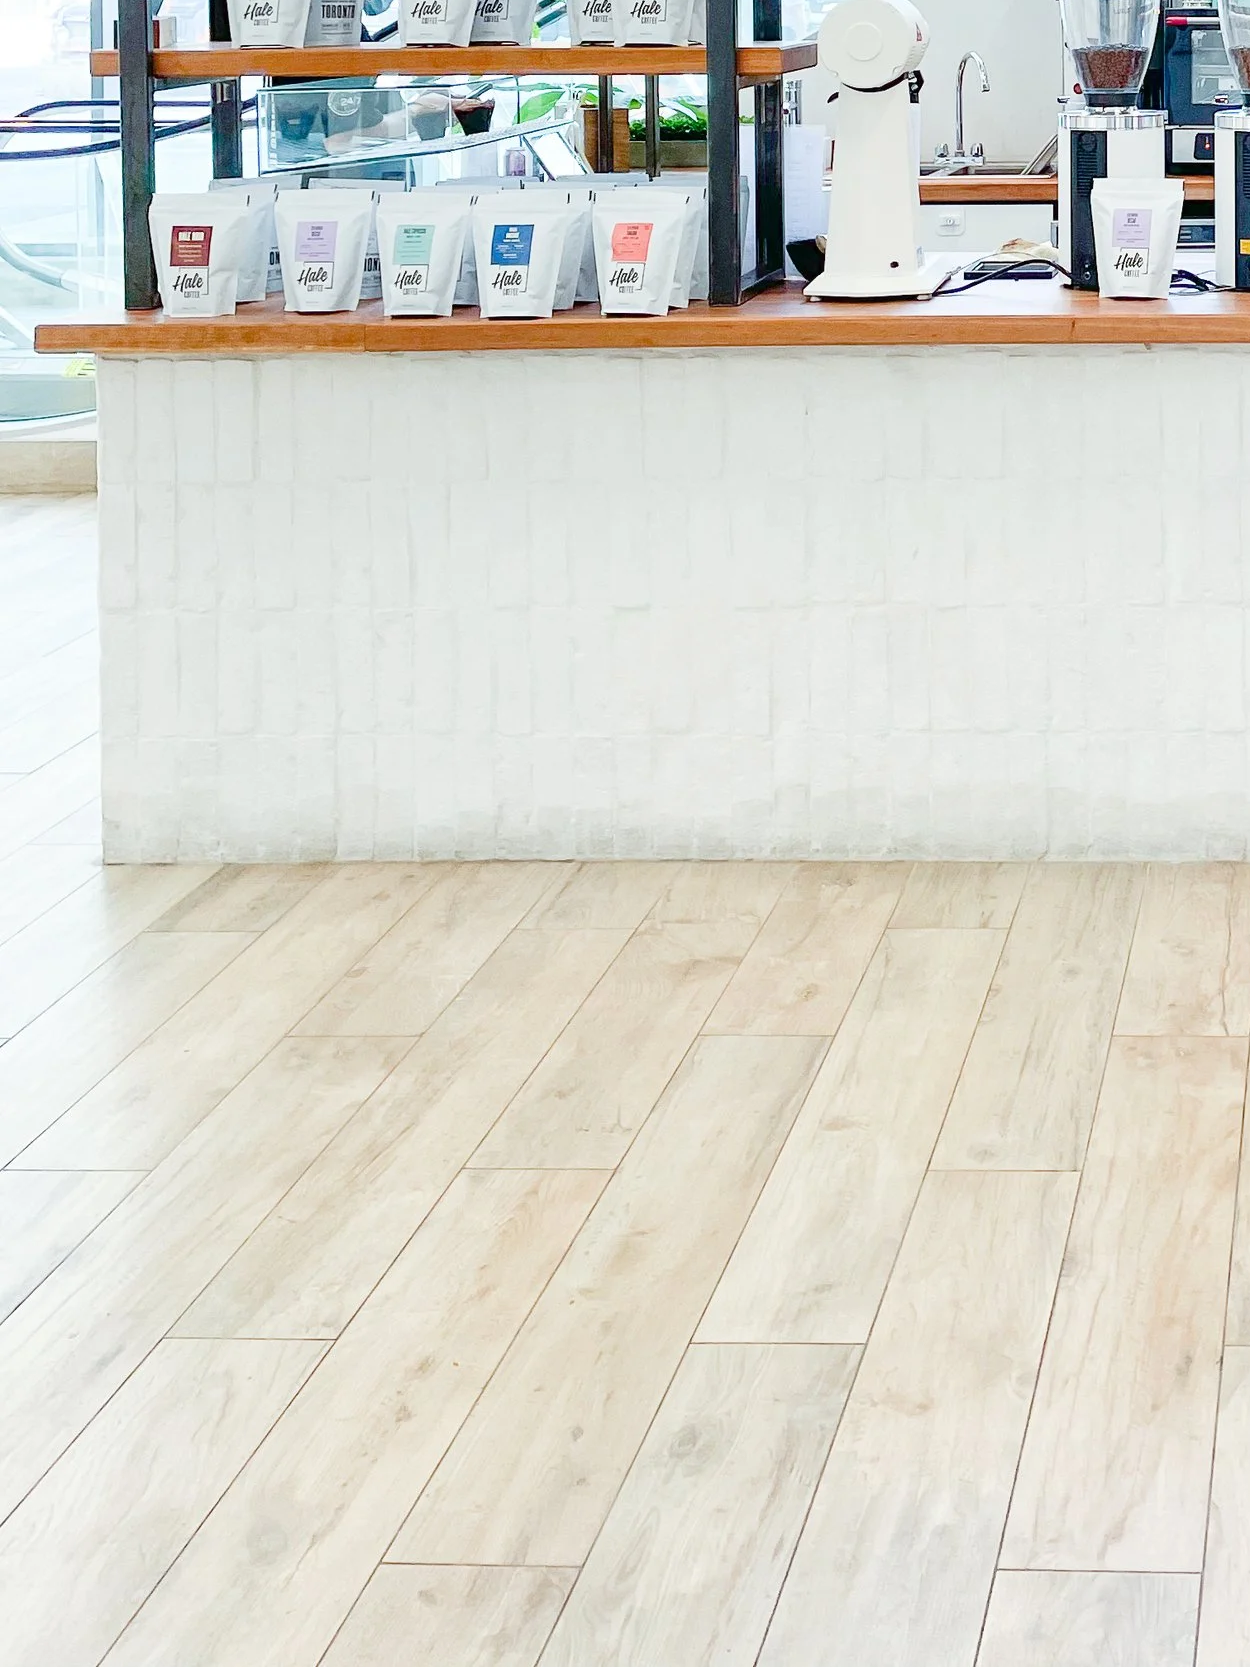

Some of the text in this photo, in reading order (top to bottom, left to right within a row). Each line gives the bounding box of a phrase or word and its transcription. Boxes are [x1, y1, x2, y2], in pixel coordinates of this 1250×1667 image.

[244, 2, 273, 21] Hale
[321, 4, 356, 19] TORONTO
[411, 0, 442, 19] Hale
[582, 0, 612, 17] Hale
[630, 0, 661, 18] Hale
[1114, 253, 1144, 271] Hale
[172, 272, 204, 293] Hale
[297, 266, 328, 286] Hale
[394, 270, 423, 289] Hale
[492, 270, 522, 290] Hale
[609, 268, 639, 287] Hale
